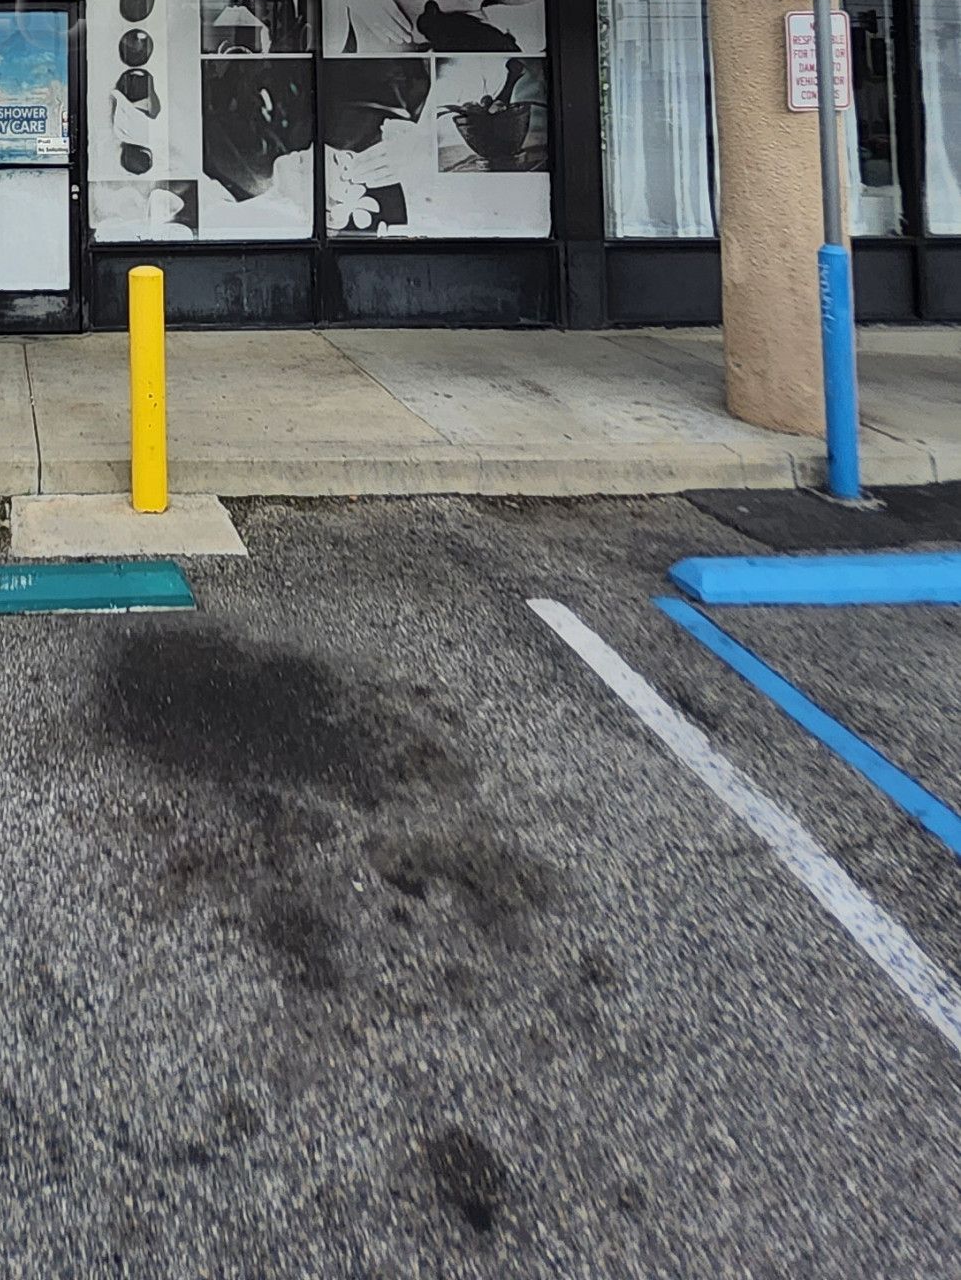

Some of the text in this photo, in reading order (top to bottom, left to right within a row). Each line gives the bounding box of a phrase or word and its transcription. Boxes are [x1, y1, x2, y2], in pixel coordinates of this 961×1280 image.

[792, 34, 846, 46] RESPBLE
[801, 90, 841, 100] CONS
[11, 121, 46, 133] CARE
